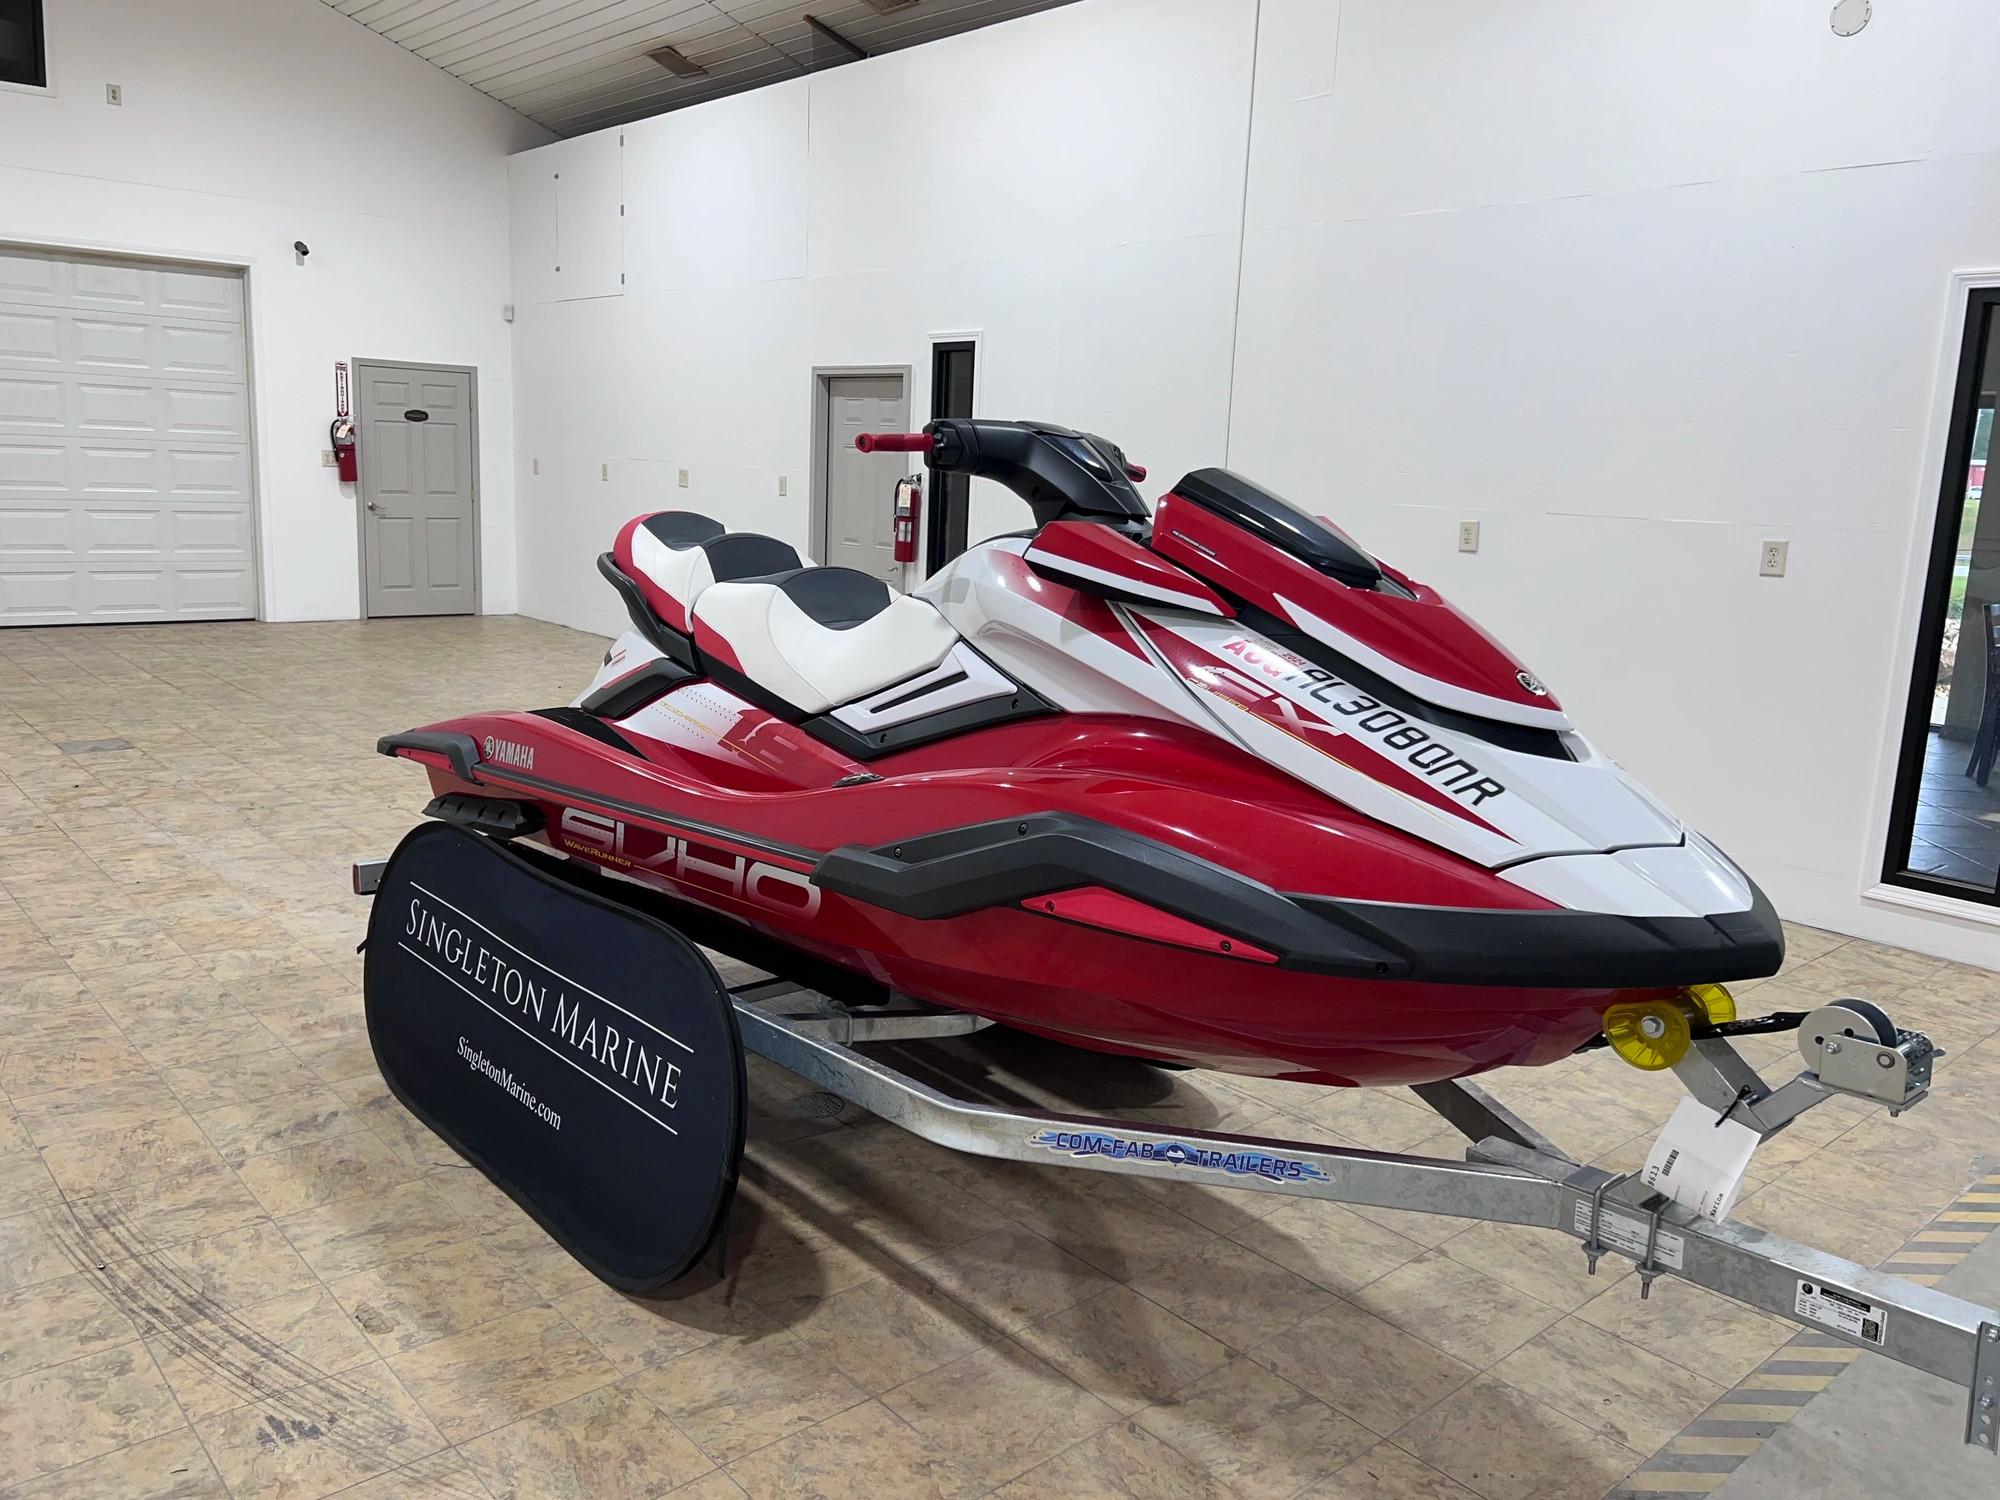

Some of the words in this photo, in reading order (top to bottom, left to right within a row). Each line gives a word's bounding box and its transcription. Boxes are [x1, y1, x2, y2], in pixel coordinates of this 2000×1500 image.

[494, 738, 534, 770] YAMAHA
[561, 806, 822, 921] SVHO
[405, 898, 548, 1023] SINGLETON
[551, 993, 683, 1110] MARINE
[456, 1035, 562, 1131] SingletonMarine.com
[1056, 1132, 1154, 1159] COM-FAB
[1196, 1149, 1303, 1177] TRAILERS
